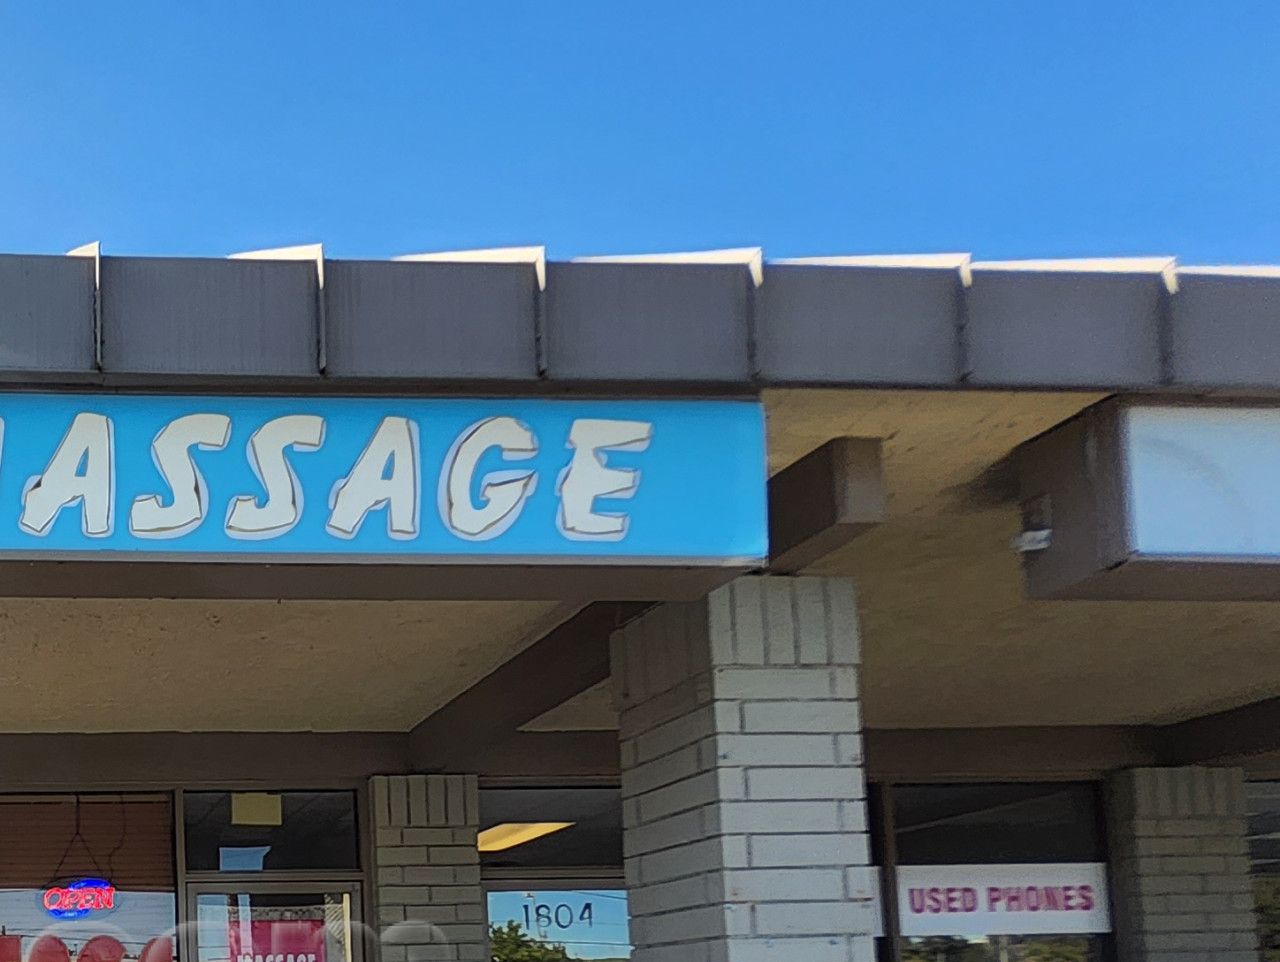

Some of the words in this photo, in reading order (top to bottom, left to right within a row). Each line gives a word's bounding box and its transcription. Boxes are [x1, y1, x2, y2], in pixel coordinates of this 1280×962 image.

[43, 886, 116, 911] OPEN
[908, 887, 978, 914] USED
[987, 884, 1095, 912] PHONES
[522, 902, 593, 930] 1804
